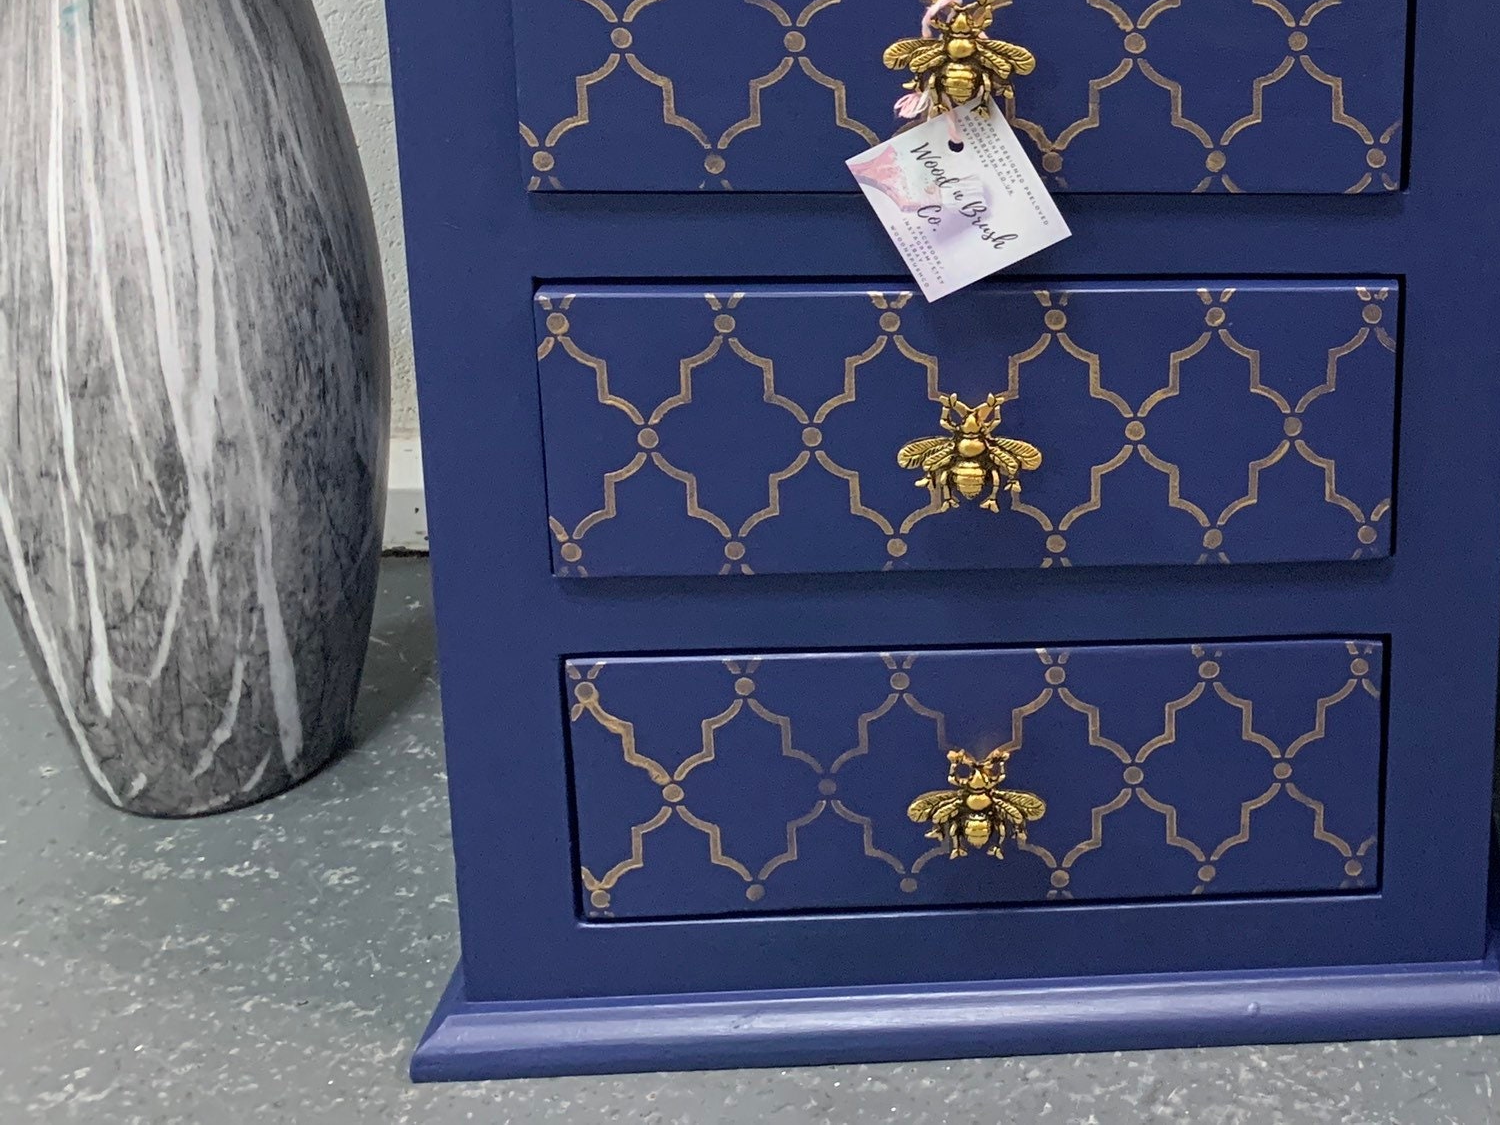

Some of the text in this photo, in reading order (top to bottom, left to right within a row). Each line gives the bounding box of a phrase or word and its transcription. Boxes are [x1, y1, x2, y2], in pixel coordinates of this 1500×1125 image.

[910, 141, 959, 188] Wood
[952, 189, 963, 200] n
[959, 200, 1018, 250] Brush
[1023, 186, 1049, 226] PRELOVED
[917, 204, 941, 232] Co.
